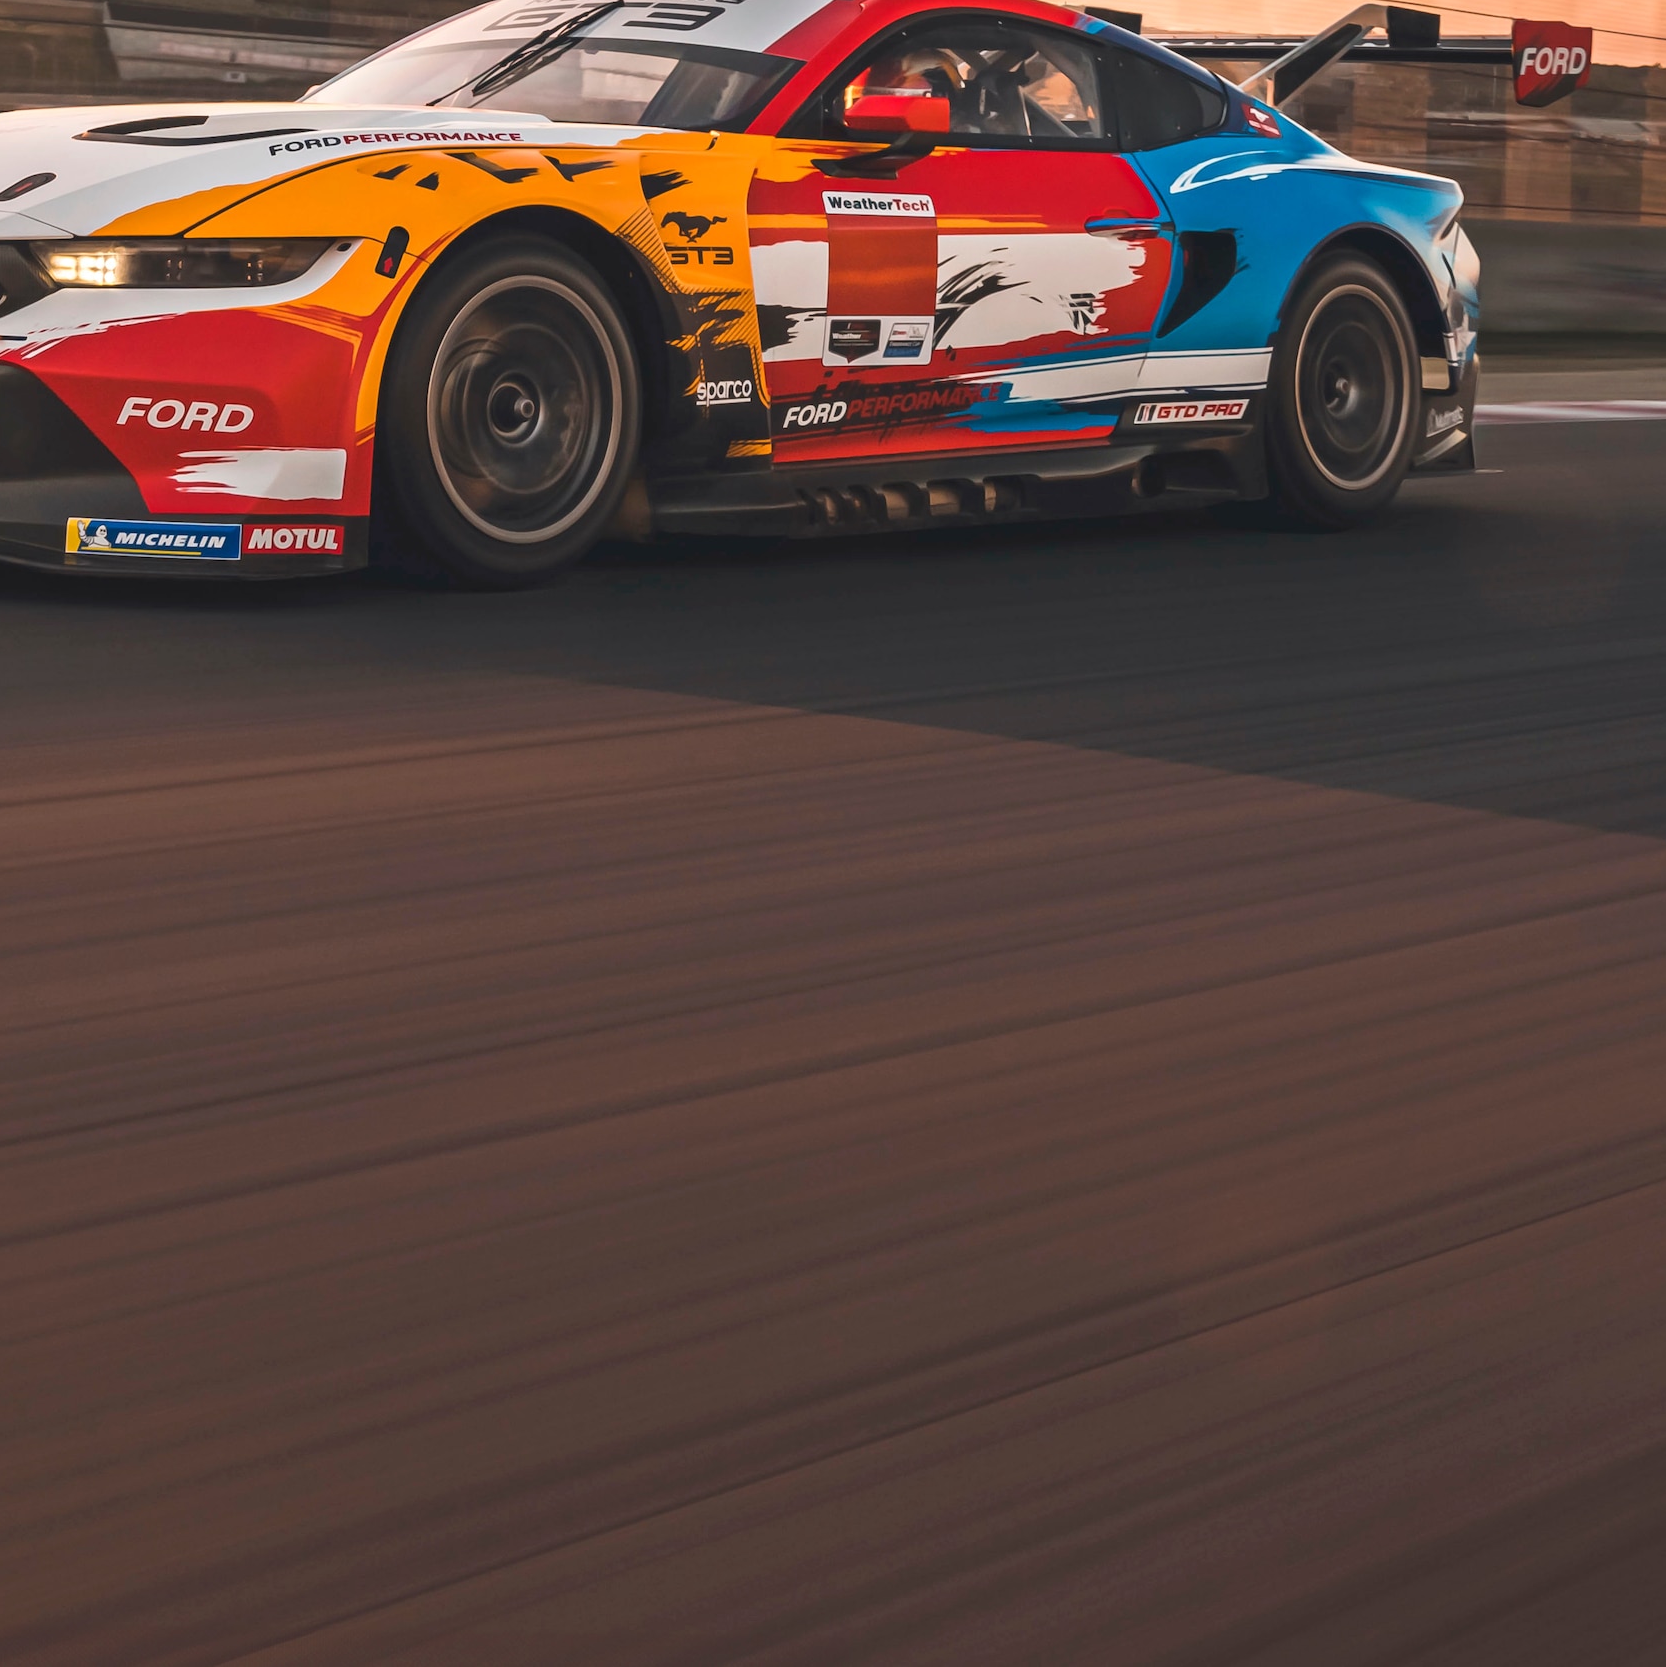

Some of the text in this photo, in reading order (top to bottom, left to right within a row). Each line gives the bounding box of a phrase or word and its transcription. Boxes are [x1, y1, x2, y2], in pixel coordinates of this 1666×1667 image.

[1520, 47, 1587, 76] FORD
[827, 196, 930, 211] WeatherTech
[696, 380, 752, 407] sparco
[116, 396, 254, 433] FORD
[1157, 403, 1244, 419] GTD PRO
[115, 532, 226, 549] MICHELIN
[248, 528, 338, 551] MOTUL
